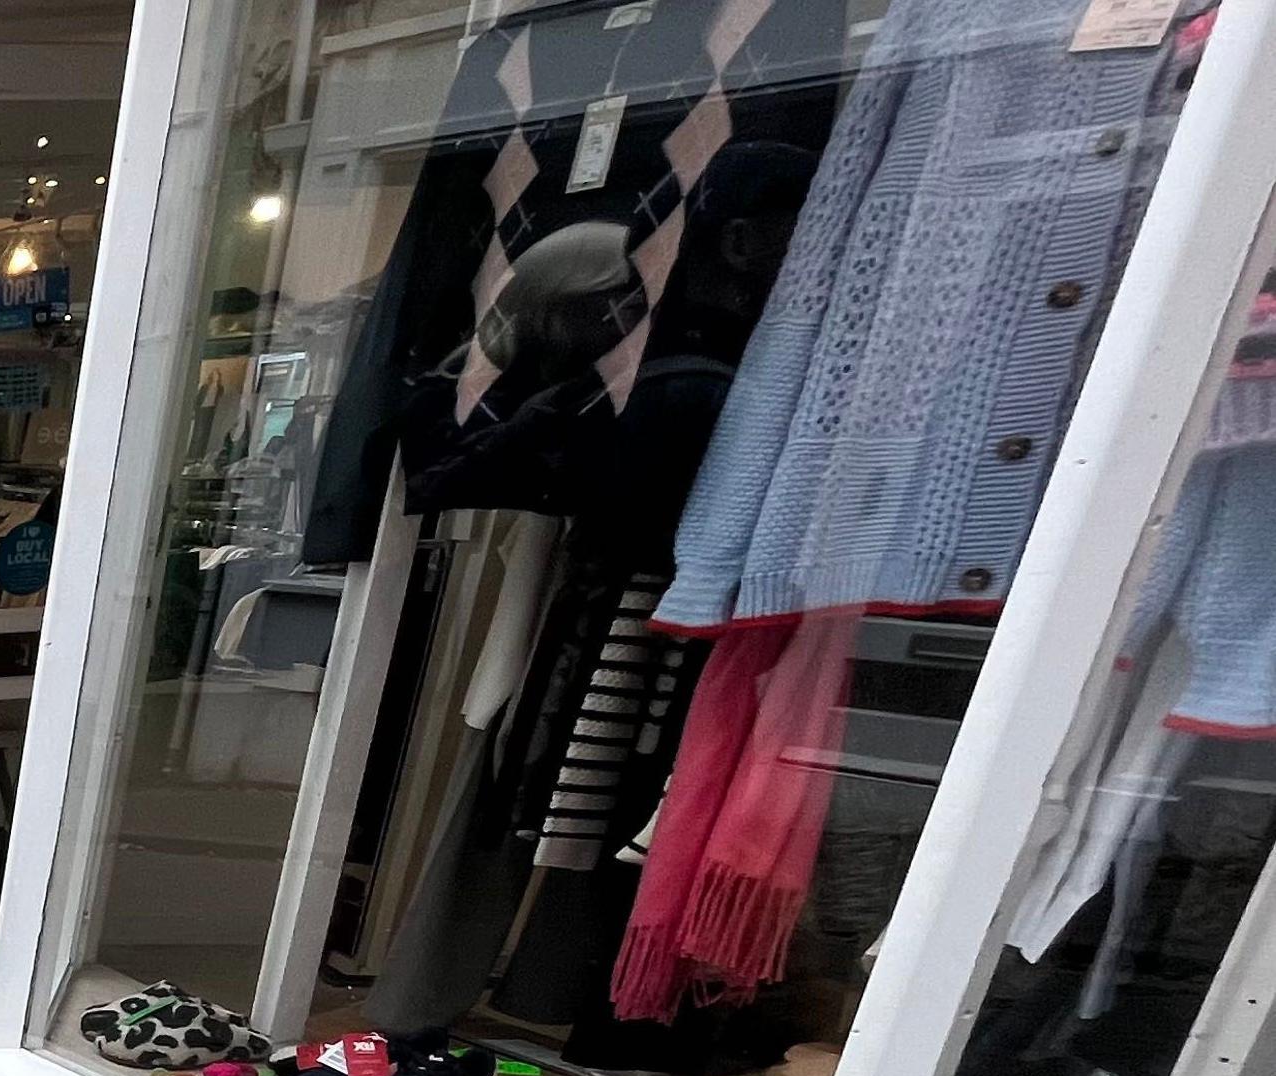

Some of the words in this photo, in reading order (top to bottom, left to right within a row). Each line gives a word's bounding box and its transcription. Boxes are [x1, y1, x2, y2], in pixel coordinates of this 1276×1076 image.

[2, 273, 47, 307] OPEN
[16, 538, 44, 552] BUY
[7, 551, 49, 565] LOCAL
